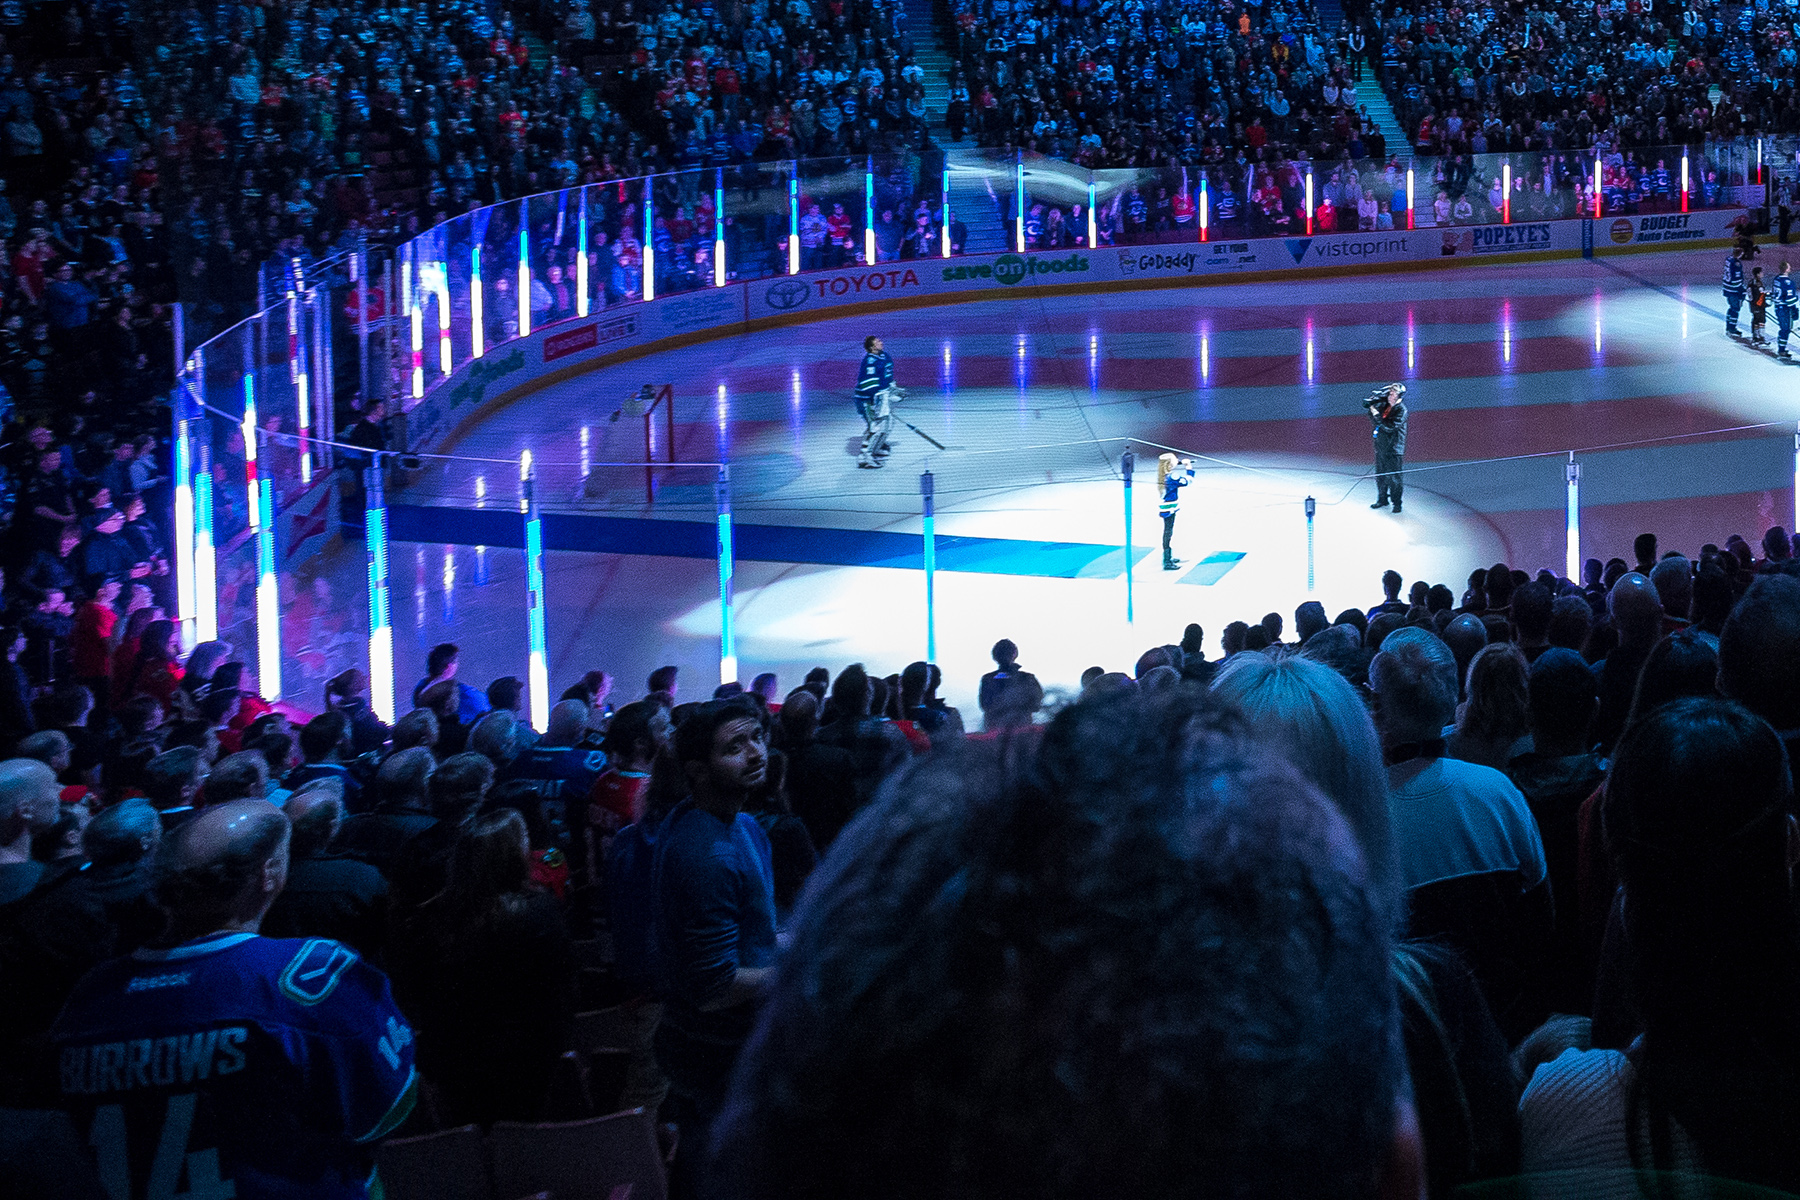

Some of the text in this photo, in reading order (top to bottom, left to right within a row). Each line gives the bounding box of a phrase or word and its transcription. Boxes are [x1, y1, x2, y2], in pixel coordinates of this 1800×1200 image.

[1640, 214, 1691, 232] BUDGET
[1315, 237, 1409, 259] vistaprint
[1637, 229, 1706, 243] Auto Centres
[942, 253, 1090, 282] save on foods
[1139, 252, 1199, 273] GoDaddy
[814, 269, 920, 298] TOYOTA
[60, 1026, 248, 1094] BURROWS
[88, 1092, 238, 1200] 14
